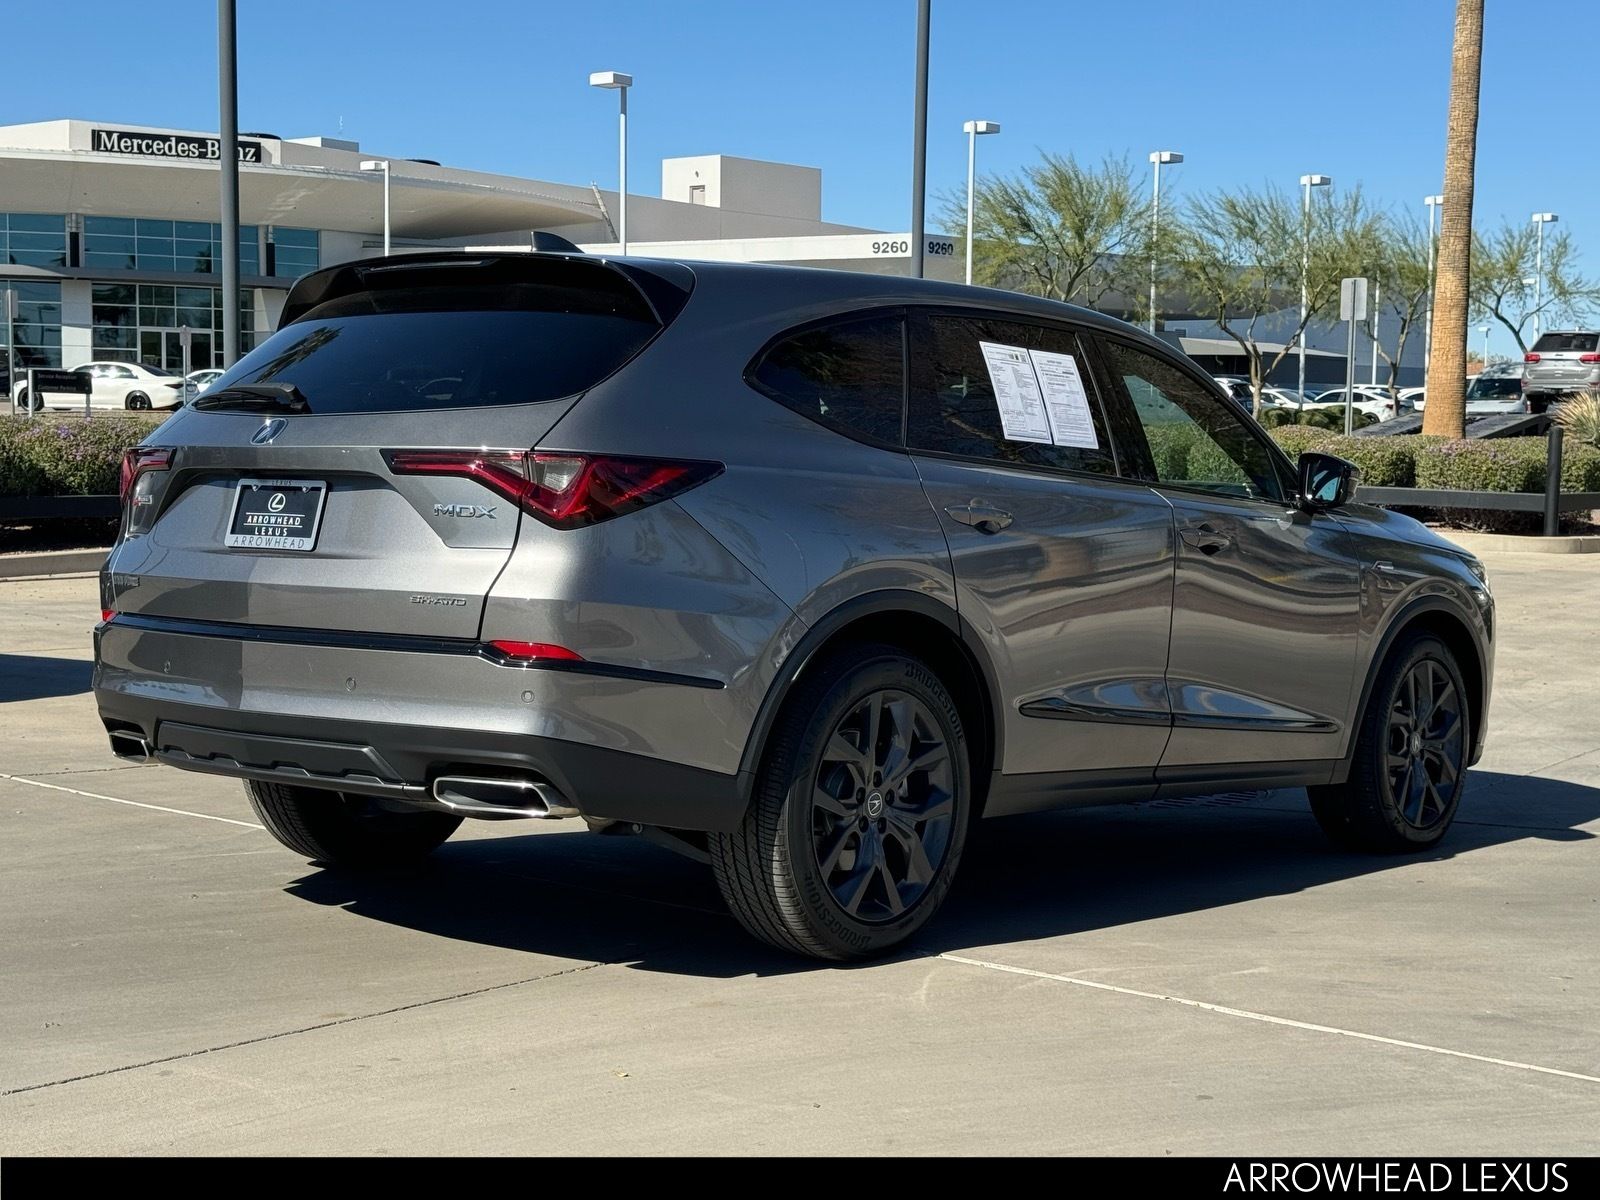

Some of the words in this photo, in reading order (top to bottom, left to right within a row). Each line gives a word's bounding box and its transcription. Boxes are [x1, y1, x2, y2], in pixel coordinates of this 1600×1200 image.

[99, 132, 256, 162] Mercedes-Bnz
[872, 241, 909, 254] 9260
[928, 241, 954, 255] 9260
[434, 503, 497, 519] MDX
[247, 515, 301, 526] ARROWHEAD
[255, 526, 288, 537] LEXUS
[233, 536, 305, 549] ARROWHEAD
[904, 662, 966, 746] BRIDGESTONE
[804, 872, 873, 951] BRIDGESTONE
